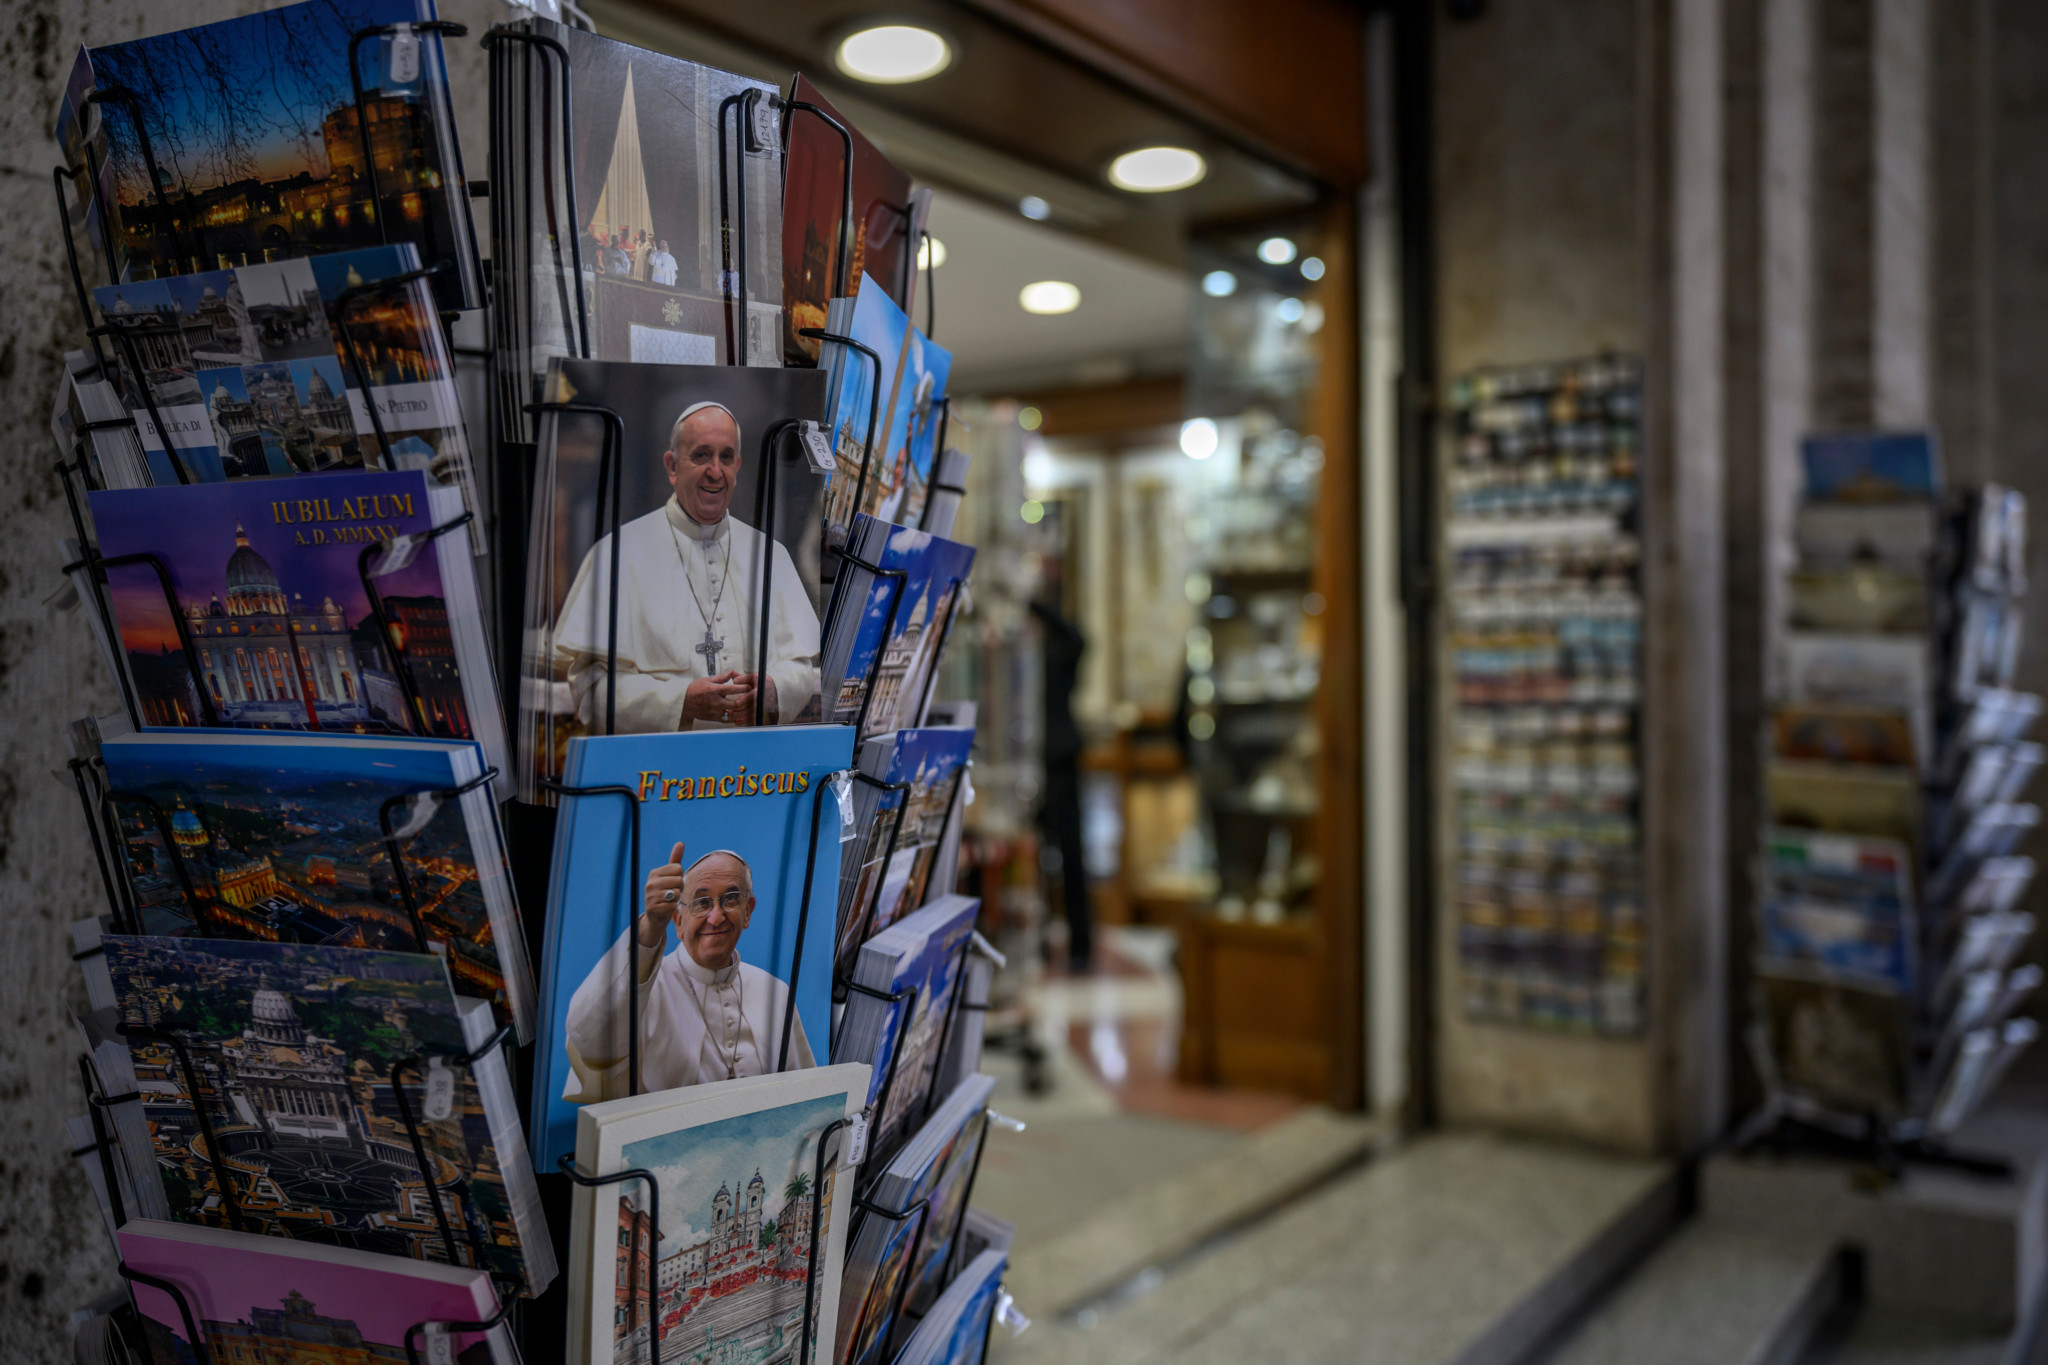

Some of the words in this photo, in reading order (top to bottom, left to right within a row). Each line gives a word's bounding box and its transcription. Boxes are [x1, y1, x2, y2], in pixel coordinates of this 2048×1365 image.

[362, 401, 386, 416] SN
[387, 399, 428, 414] PIETRO
[146, 421, 190, 435] BILICA
[190, 420, 202, 431] DI
[271, 493, 414, 525] IUBILAEUM
[294, 530, 310, 546] A.
[312, 528, 331, 545] D.
[333, 524, 401, 545] MMXXV
[637, 765, 810, 803] Franciscus
